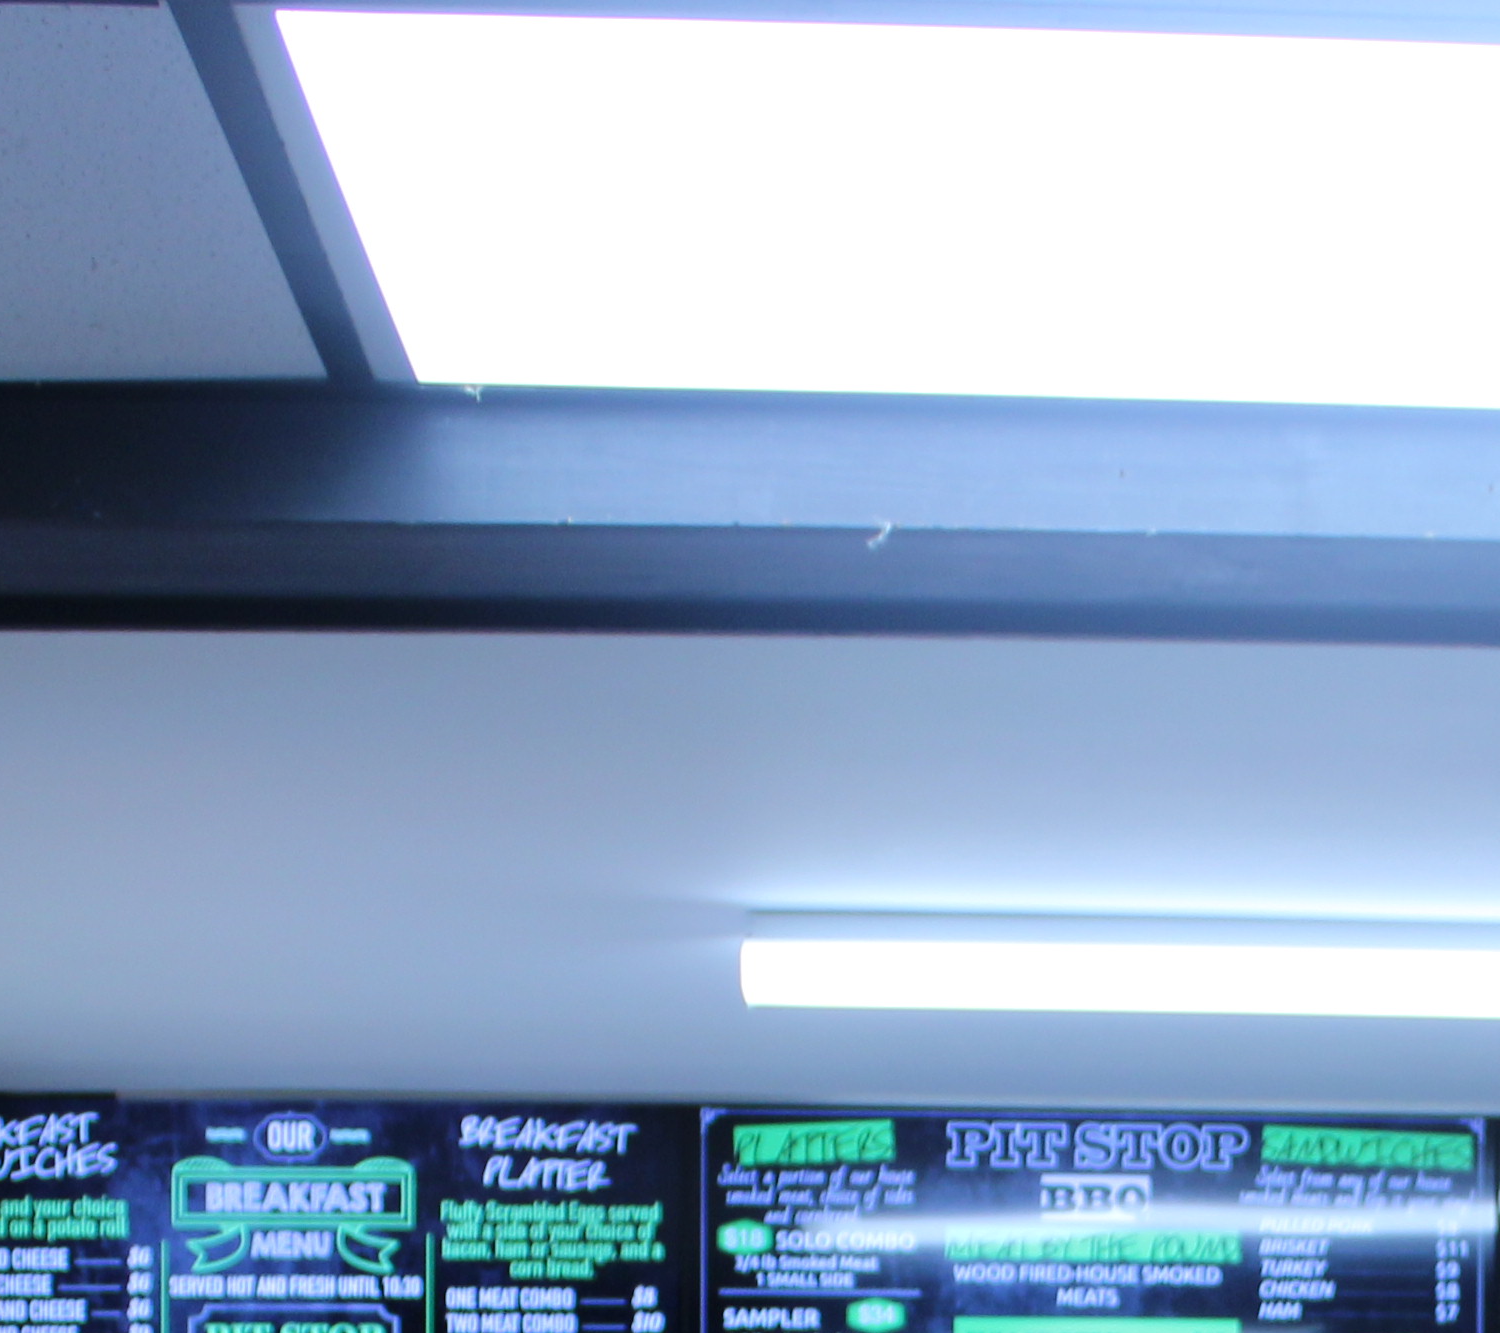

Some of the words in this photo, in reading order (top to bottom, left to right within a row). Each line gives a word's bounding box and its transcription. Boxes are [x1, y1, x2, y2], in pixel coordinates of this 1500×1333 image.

[267, 1120, 317, 1152] OUR
[458, 1115, 638, 1154] BREAKFAST
[735, 1128, 894, 1164] PLATTERS
[946, 1121, 1071, 1170] PIT
[1074, 1122, 1250, 1171] STOP
[483, 1155, 612, 1191] PLATTER
[205, 1182, 386, 1213] BREAKFAST
[12, 1247, 70, 1271] CHEESE
[127, 1245, 154, 1269] $6
[251, 1231, 333, 1260] MENU
[953, 1263, 1016, 1284] WOOD
[1141, 1266, 1223, 1287] SMOKED
[1261, 1259, 1328, 1278] TURKEY
[1436, 1260, 1461, 1280] $9
[127, 1272, 154, 1295] $6
[169, 1275, 224, 1298] SERVED
[227, 1275, 255, 1298] HOT
[257, 1275, 288, 1298] AND
[289, 1275, 336, 1298] FRESH
[338, 1275, 381, 1298] UNTIL
[1259, 1279, 1336, 1299] CHICKEN
[1436, 1281, 1461, 1301] $8
[29, 1299, 87, 1322] CHEESE
[127, 1298, 154, 1321] $6
[446, 1287, 477, 1310] ONE
[479, 1287, 519, 1310] MEAT
[520, 1287, 576, 1310] COMBO
[632, 1285, 658, 1309] $8
[1056, 1288, 1120, 1308] MEATS
[632, 1310, 665, 1333] $10
[723, 1307, 821, 1330] SAMPLER
[858, 1303, 896, 1325] $34
[1259, 1301, 1302, 1319] HAM
[1436, 1302, 1460, 1324] $7
